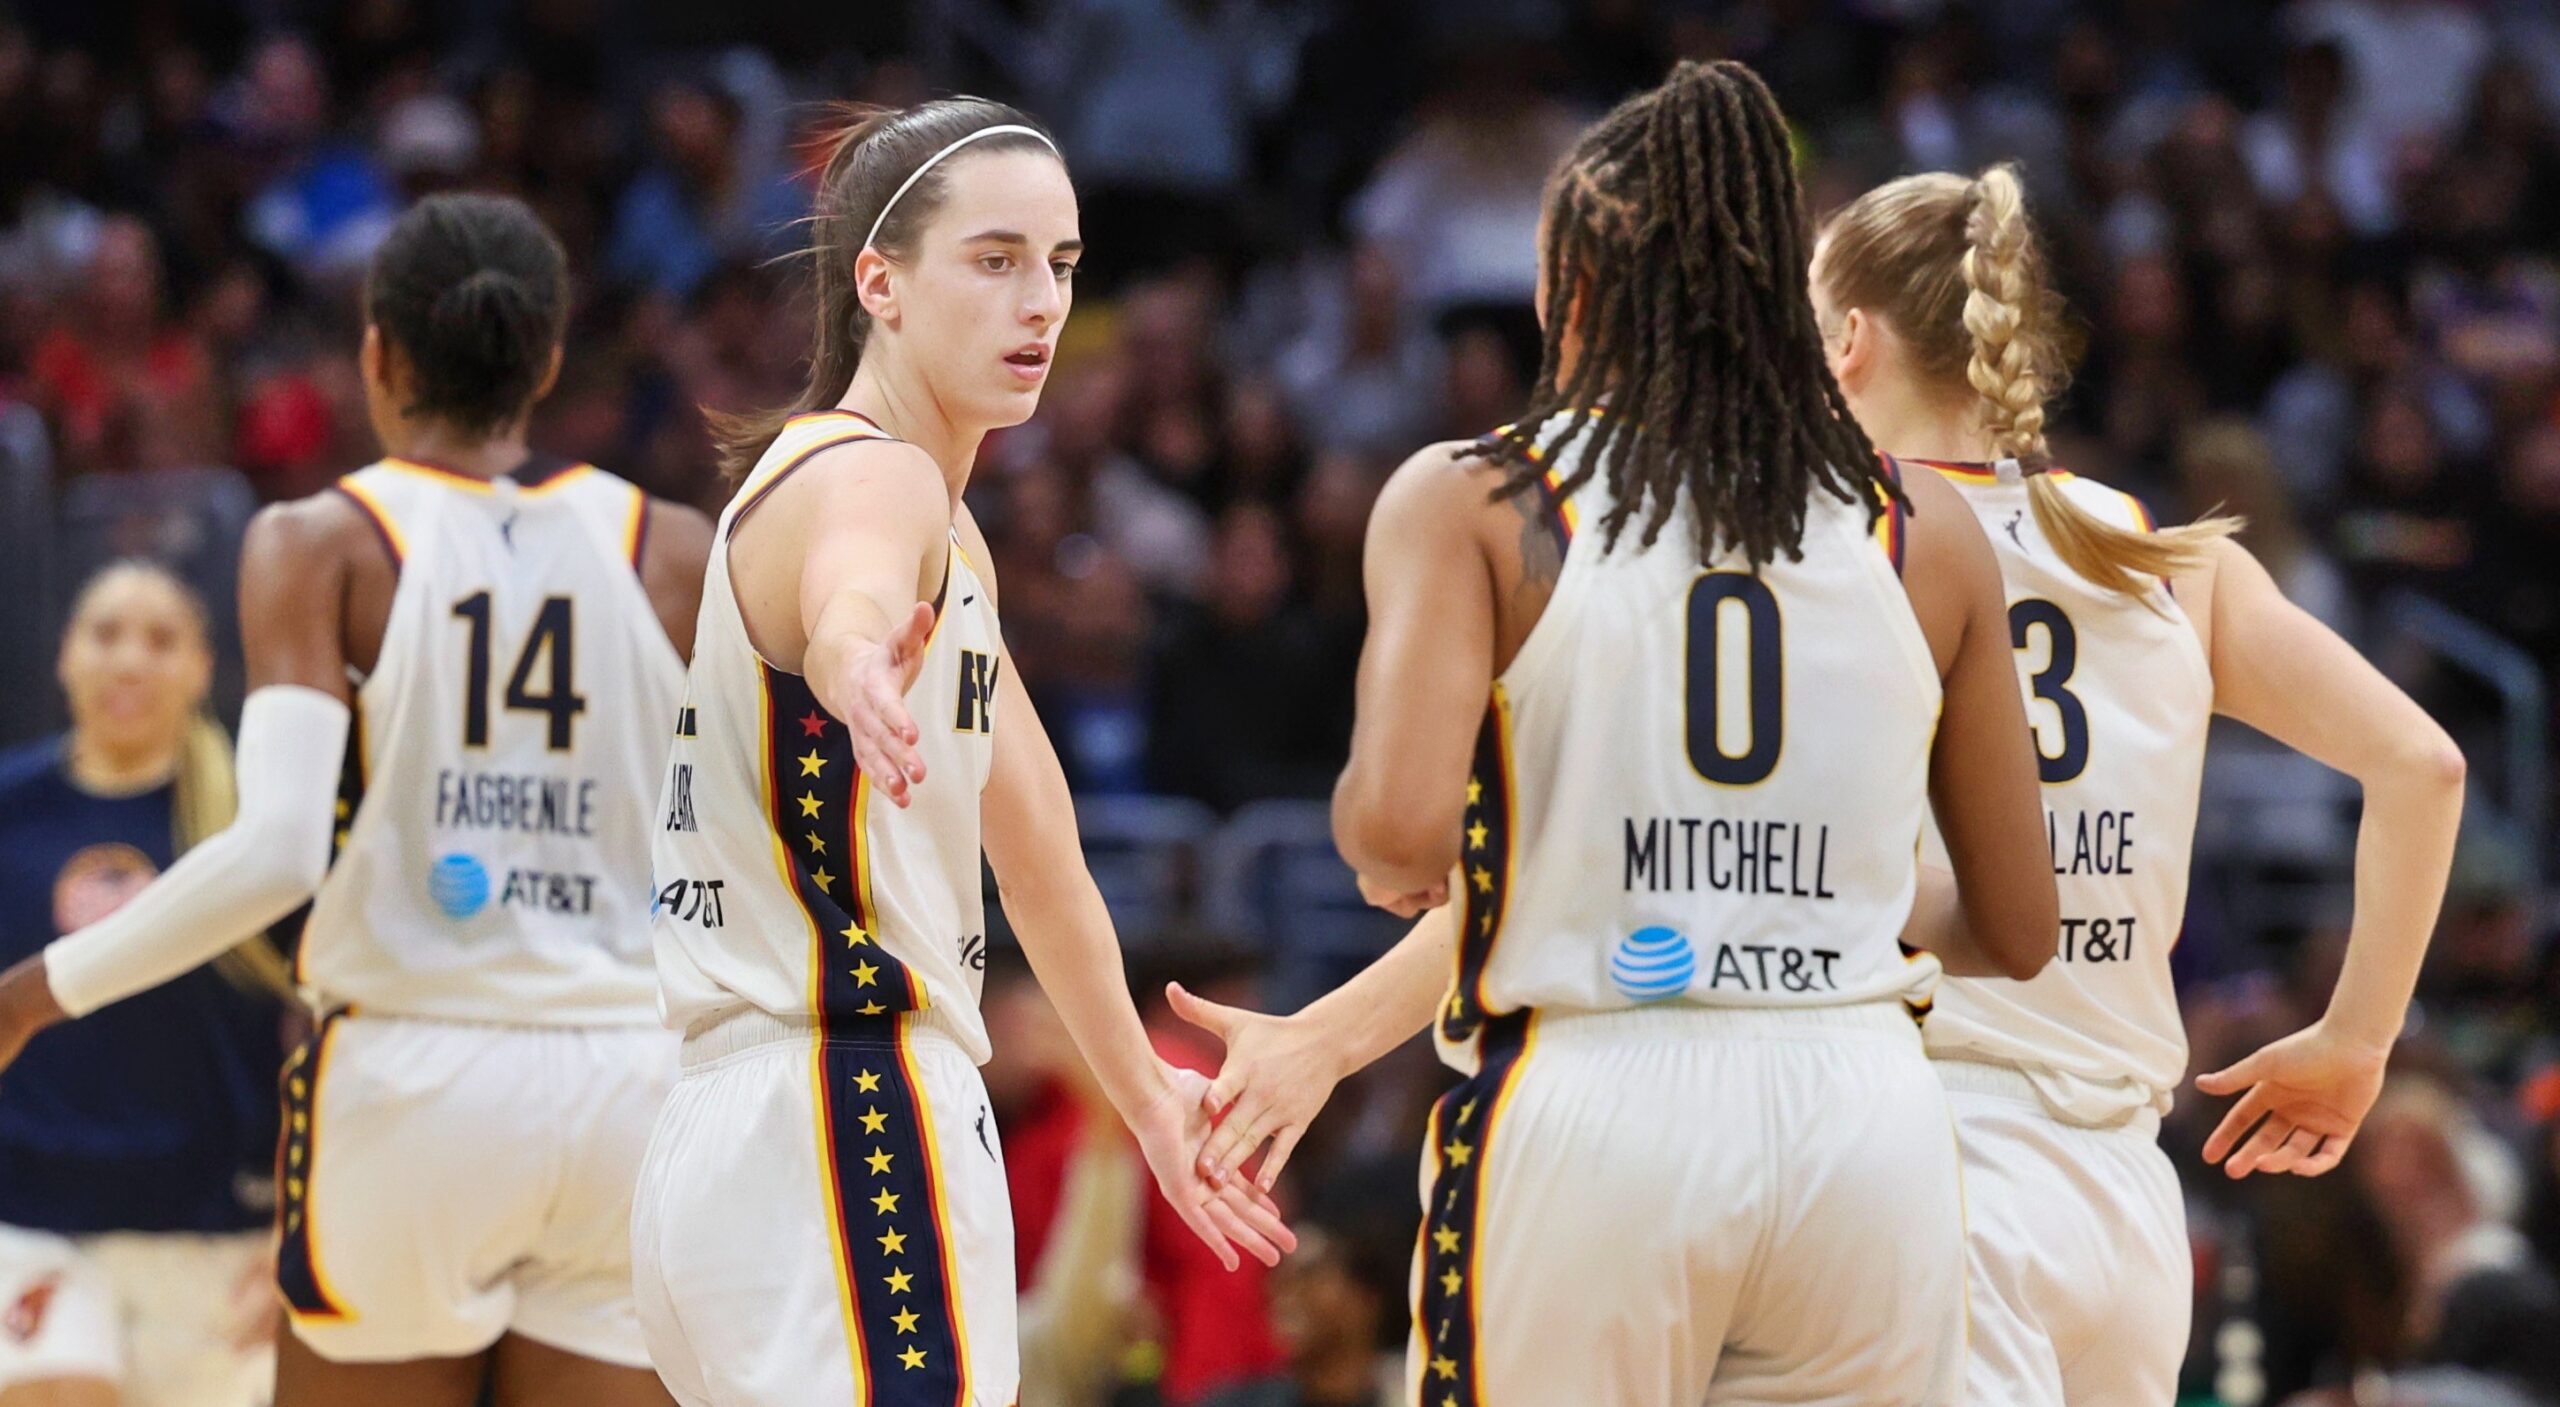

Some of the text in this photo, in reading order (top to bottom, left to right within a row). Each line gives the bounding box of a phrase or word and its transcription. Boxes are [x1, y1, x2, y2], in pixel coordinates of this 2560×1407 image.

[451, 589, 587, 750] 14
[1684, 568, 1785, 789] 0
[2008, 598, 2090, 784] 3
[434, 768, 598, 837] FAGBENLE
[1624, 817, 1835, 900] MITCHELL
[2049, 810, 2135, 876] LACE
[502, 867, 597, 915] AT&T
[1710, 943, 1842, 991] AT&T
[2056, 916, 2137, 964] T&T
